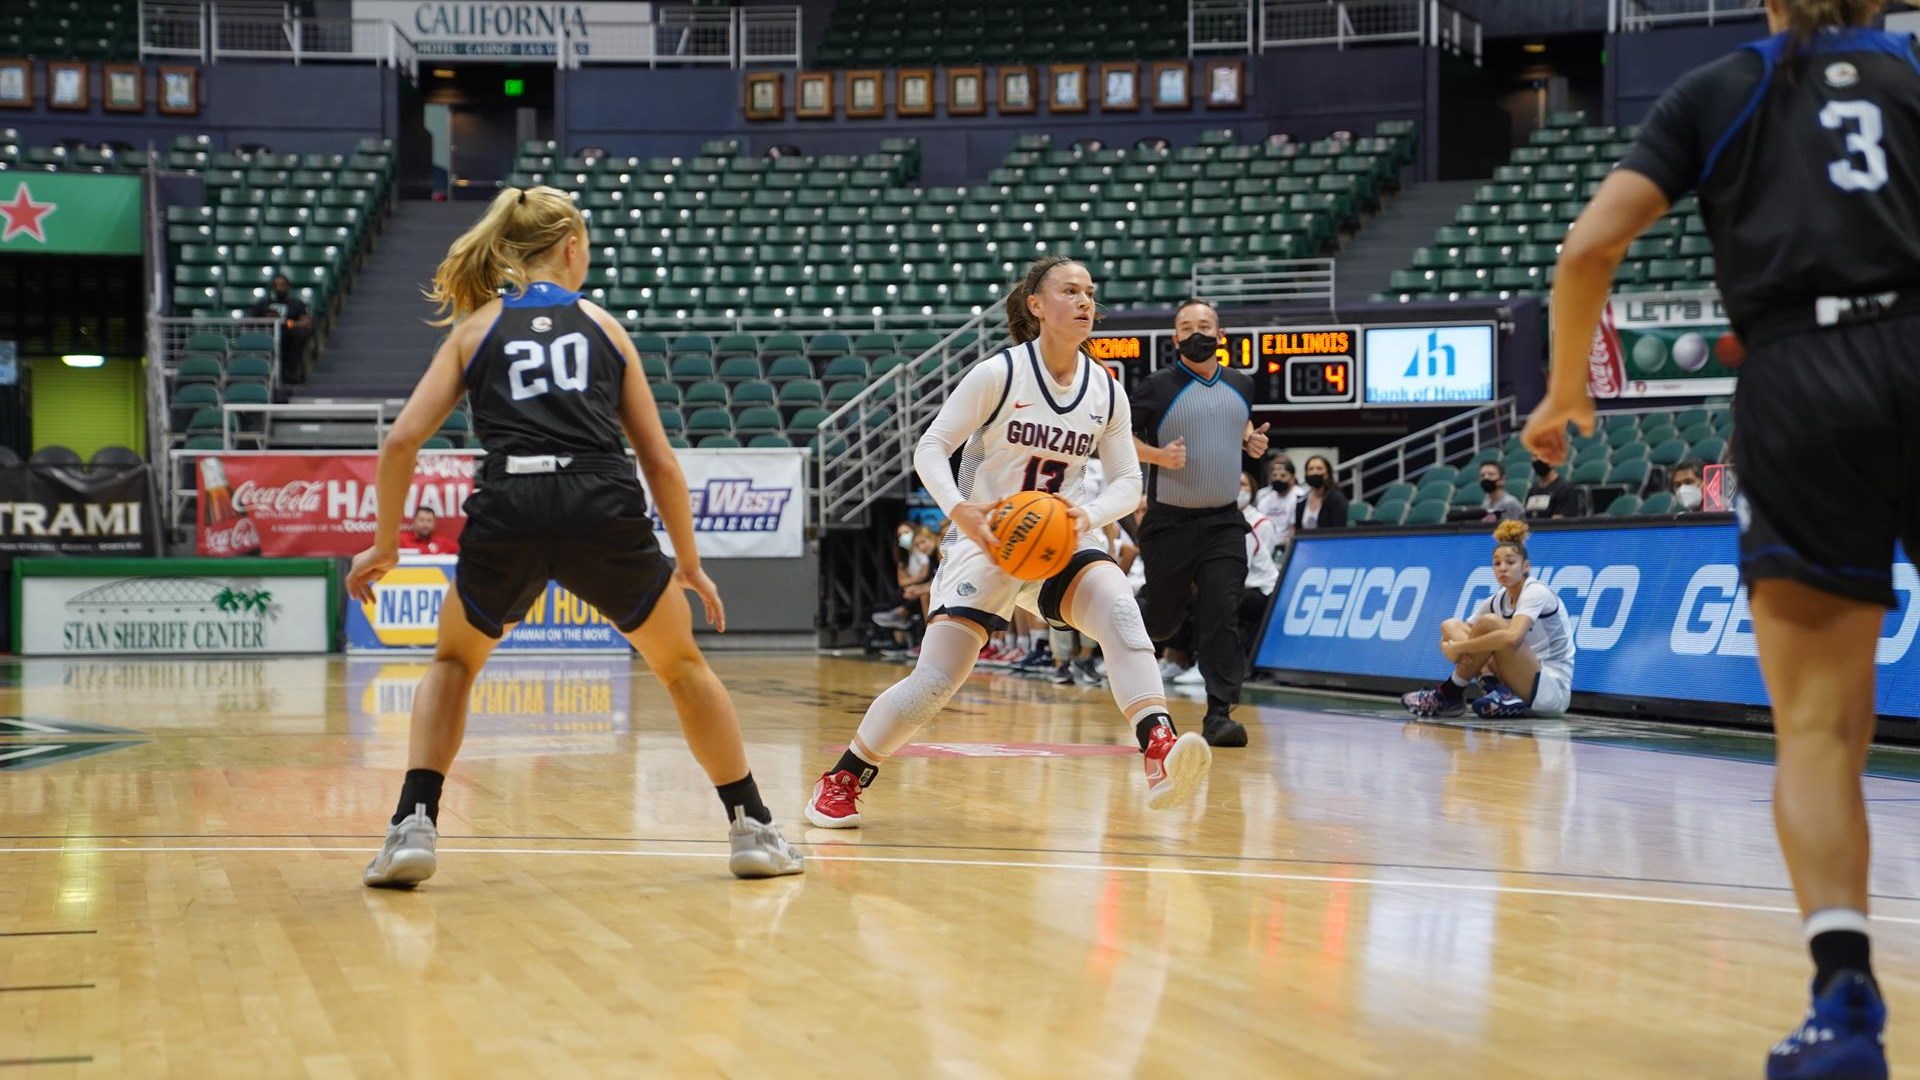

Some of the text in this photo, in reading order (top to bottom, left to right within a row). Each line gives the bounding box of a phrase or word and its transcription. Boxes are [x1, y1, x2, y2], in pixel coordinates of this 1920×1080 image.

[415, 4, 589, 36] CALIFORNIA
[1819, 100, 1889, 192] 3
[1626, 300, 1702, 321] LET'S
[1089, 337, 1140, 358] NZAGA
[1262, 332, 1349, 355] EILLINOIS
[504, 332, 589, 401] 20
[1324, 364, 1345, 393] 4
[1368, 383, 1492, 402] Bank of Hawaii
[1021, 455, 1069, 494] 13
[231, 479, 468, 519] Coca-Cola HAAII
[653, 515, 778, 531] CFERENCE
[1001, 511, 1041, 560] Wilson
[381, 589, 442, 624] NAPA
[1283, 566, 1431, 641] GEICO
[1453, 564, 1641, 650] GCO
[64, 620, 265, 650] STAN SHERIFF CENTER
[546, 628, 562, 641] ON
[563, 628, 581, 641] THE
[582, 628, 611, 641] MOVE
